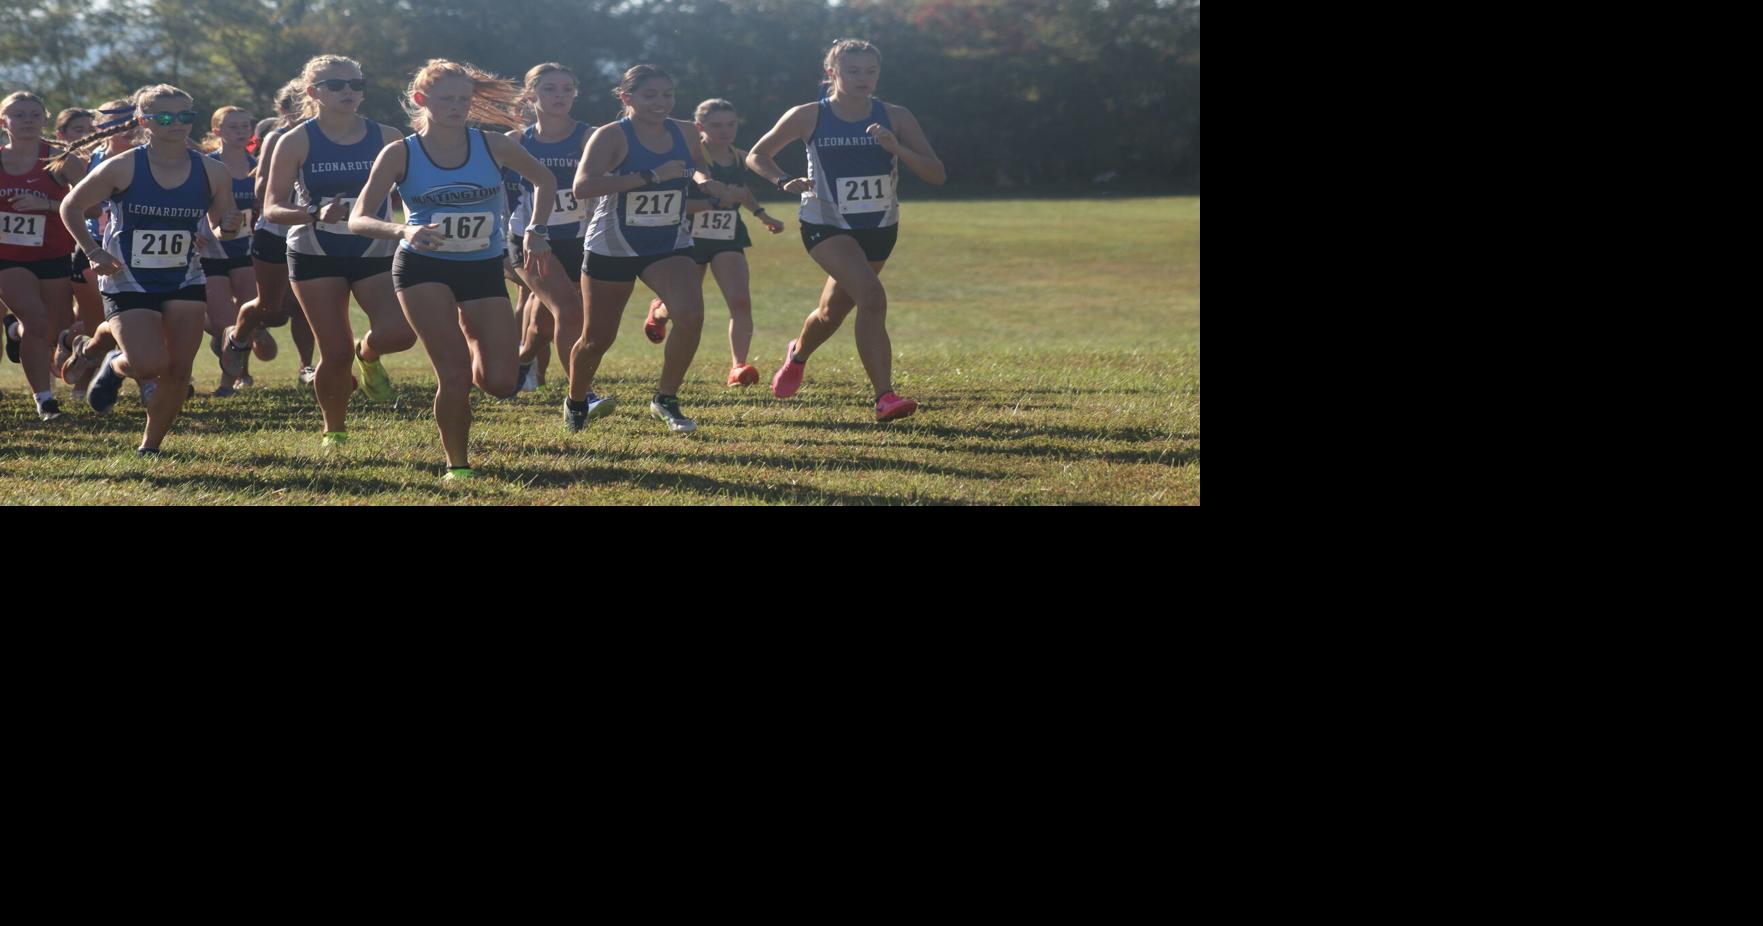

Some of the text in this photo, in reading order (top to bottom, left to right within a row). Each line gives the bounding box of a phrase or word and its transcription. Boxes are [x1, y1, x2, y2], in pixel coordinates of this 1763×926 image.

[818, 136, 880, 147] LEONARDTO
[845, 178, 885, 201] 211
[128, 203, 205, 218] LEONARDTOWN
[554, 191, 578, 212] 13
[635, 193, 675, 215] 217
[2, 215, 36, 235] 121
[442, 215, 486, 239] 167
[700, 212, 732, 230] 152
[141, 233, 184, 255] 216
